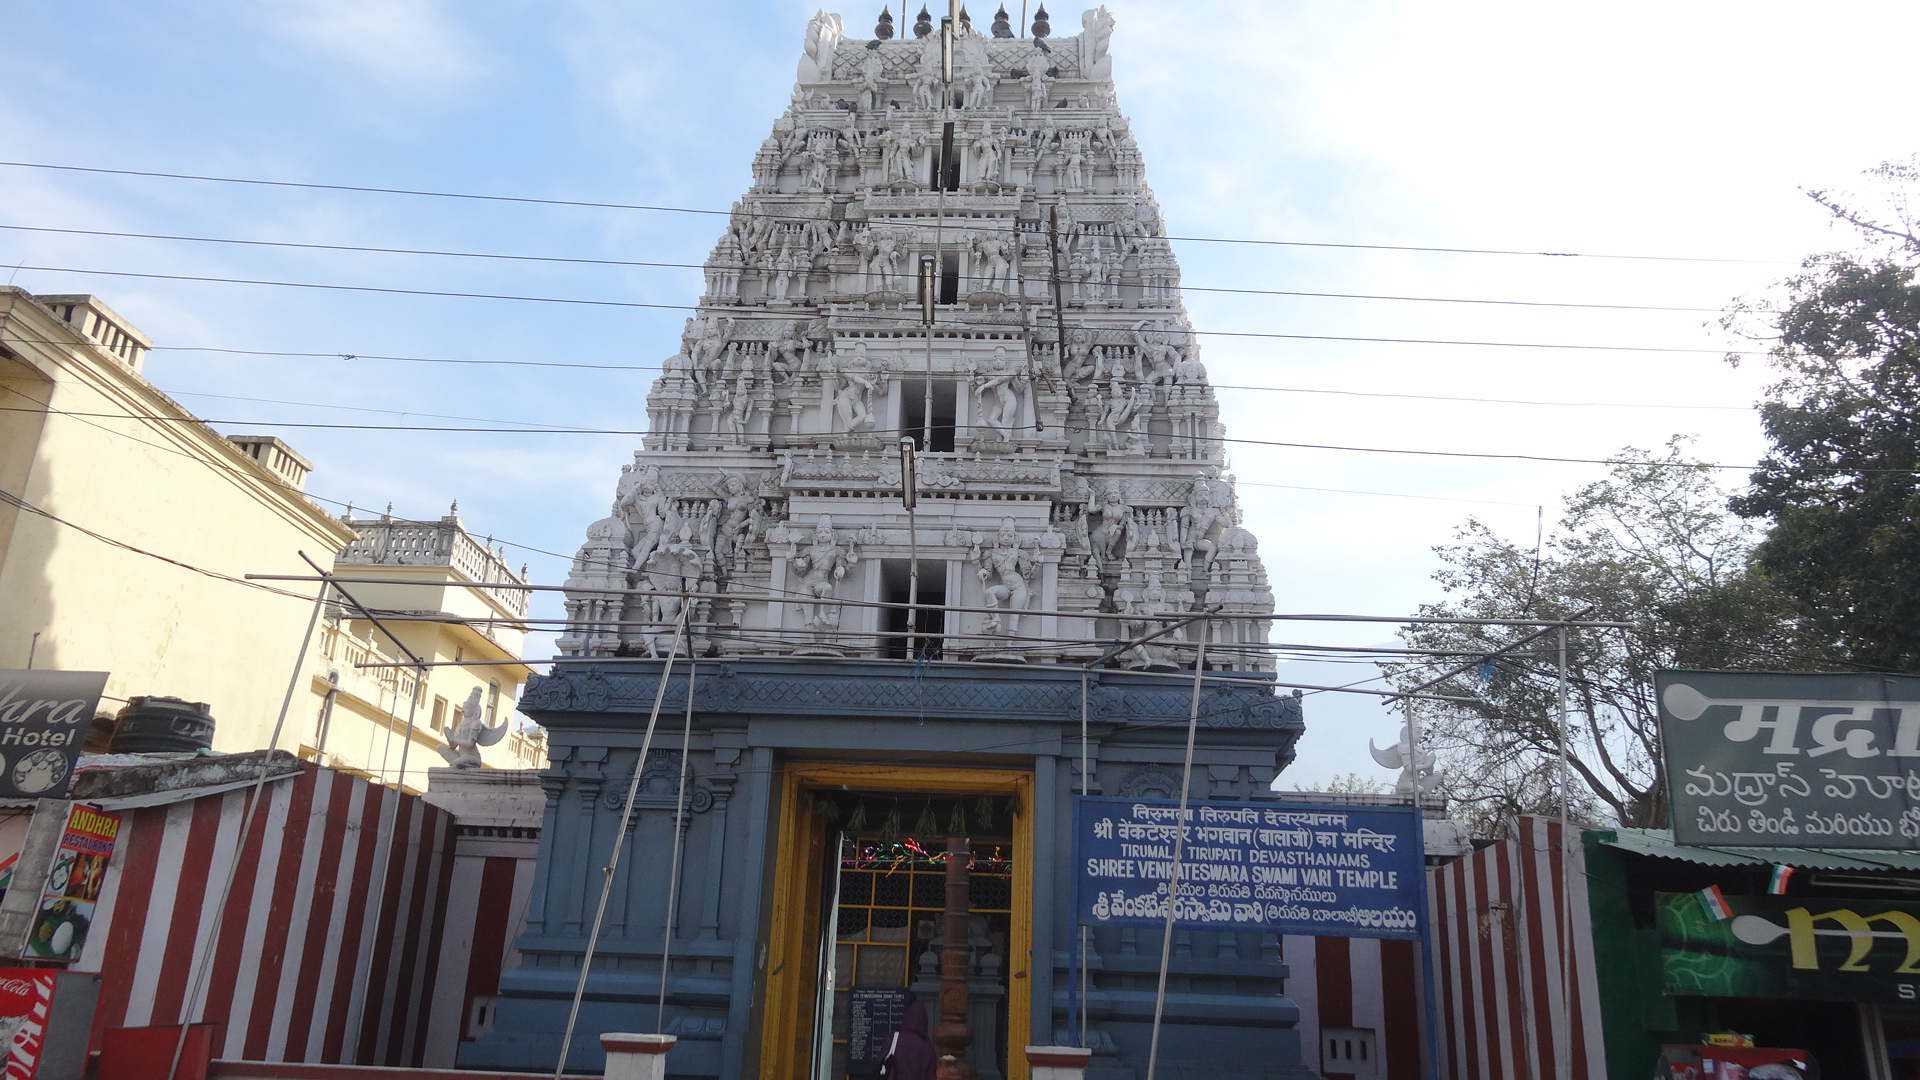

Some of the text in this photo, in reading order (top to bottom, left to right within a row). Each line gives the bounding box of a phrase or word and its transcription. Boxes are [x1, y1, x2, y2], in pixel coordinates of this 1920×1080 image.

[1, 727, 76, 746] Hotel
[1685, 762, 1811, 806] మద్రాస్
[69, 809, 119, 838] ANDHRA
[1199, 806, 1259, 824] तिरुपति
[1264, 809, 1348, 830] देवस्थानम्
[1696, 805, 1742, 833] చిరు
[1748, 807, 1800, 835] తిండి
[1805, 810, 1893, 836] మరియు
[63, 833, 114, 854] RESTAURANT
[1093, 818, 1114, 840] श्री
[1195, 825, 1253, 845] भगवान
[1315, 831, 1338, 848] का
[1341, 828, 1397, 853] मन्दिर
[1187, 846, 1242, 862] TIRUPATI
[1249, 850, 1371, 869] DEVASTHANAMS
[1087, 858, 1398, 889] SHREE VENKATESWARA SWAMI VARI TEMPLE
[1207, 883, 1251, 899] తిరుపతి
[1233, 901, 1263, 923] వారి
